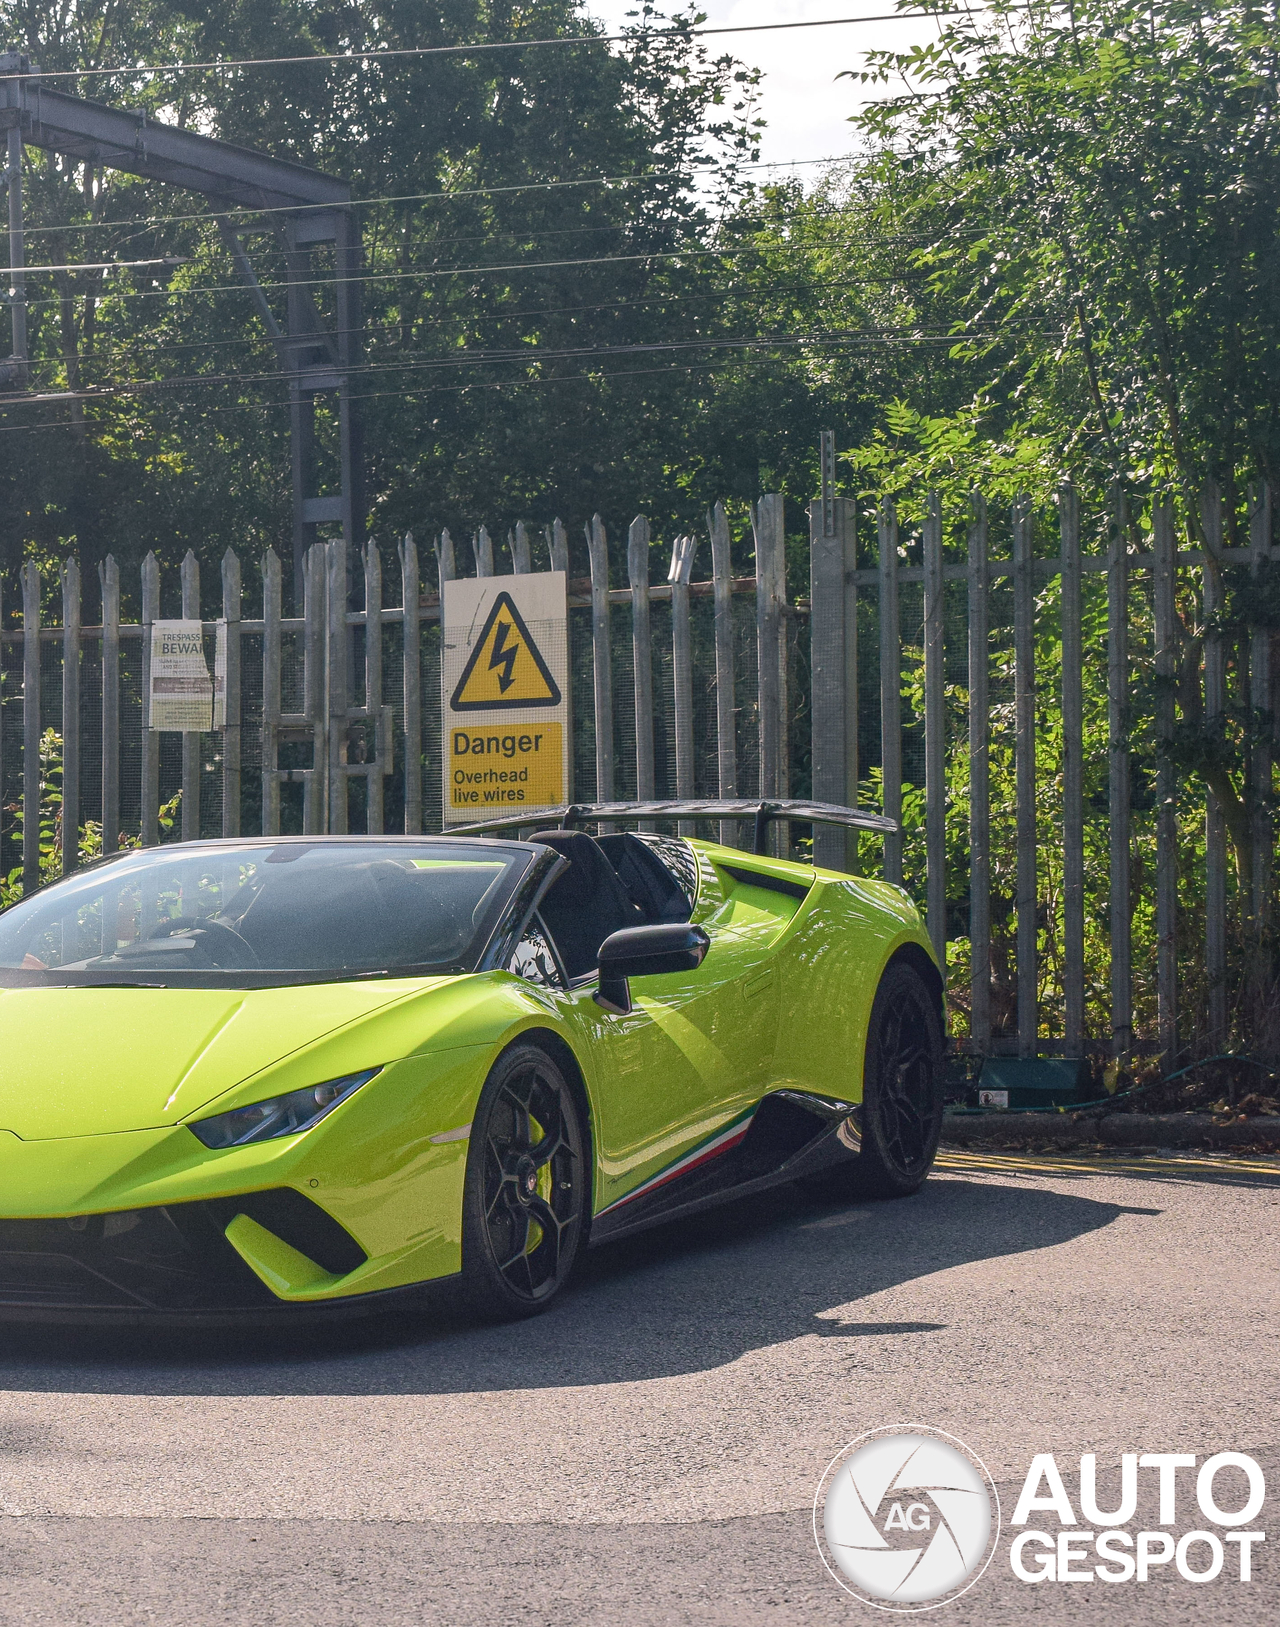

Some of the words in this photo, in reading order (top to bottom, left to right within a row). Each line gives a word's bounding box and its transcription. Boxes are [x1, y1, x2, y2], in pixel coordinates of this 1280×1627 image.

[454, 732, 543, 758] Danger
[454, 767, 528, 784] Overhead
[454, 788, 479, 803] live
[483, 787, 525, 802] wires
